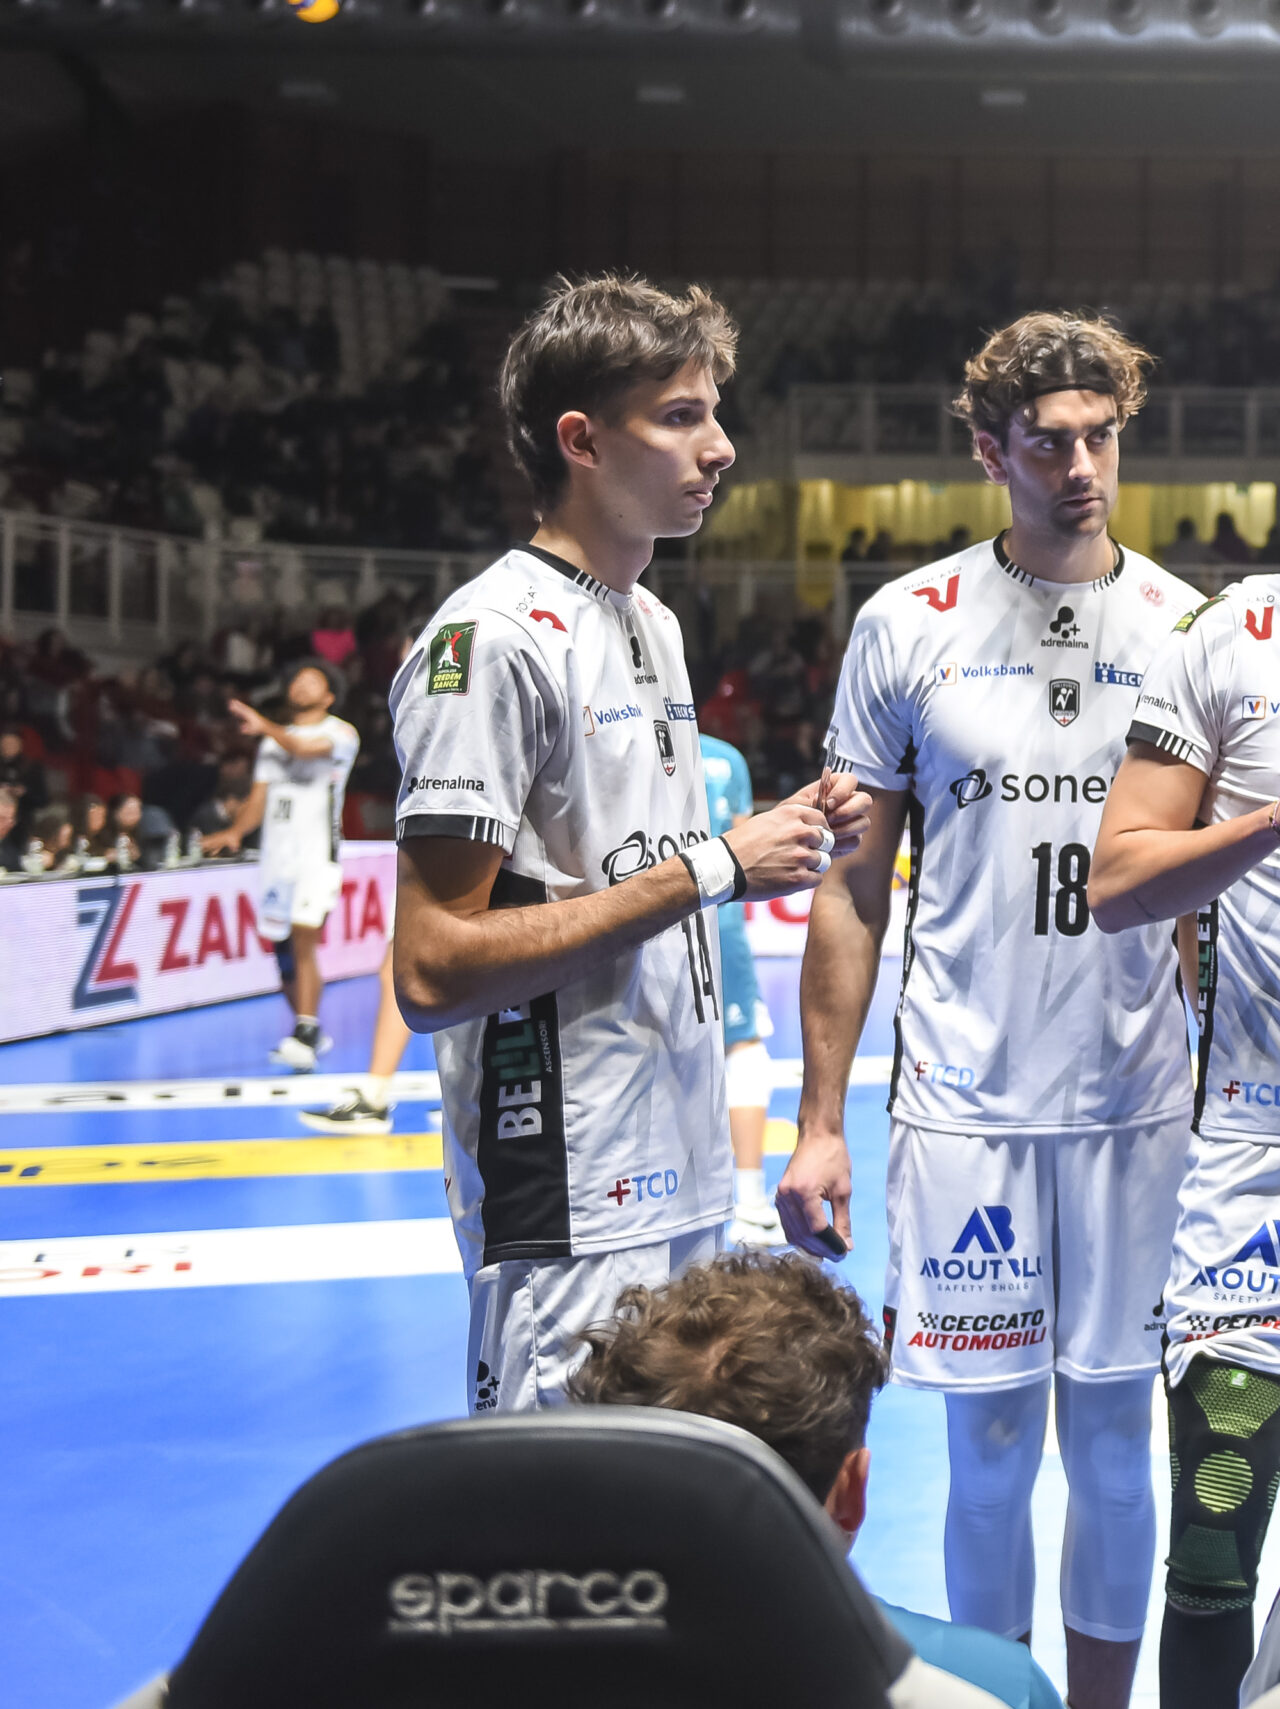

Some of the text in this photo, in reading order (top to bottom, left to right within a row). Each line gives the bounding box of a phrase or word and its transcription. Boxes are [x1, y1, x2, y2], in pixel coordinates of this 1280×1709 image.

[1041, 637, 1089, 649] adrenalina
[433, 672, 462, 682] CREDEM
[961, 663, 1034, 678] Volksbank
[433, 680, 459, 690] BANCA
[1001, 773, 1114, 804] sone
[1031, 841, 1091, 937] 18
[681, 910, 720, 1025] 14
[920, 1257, 1003, 1280] ABOUT
[937, 1283, 984, 1293] SAFETY
[1213, 1292, 1262, 1304] SAFETY
[940, 1308, 1045, 1332] CECCATO
[907, 1326, 1047, 1352] AUTOMOBILI
[388, 1568, 670, 1637] sparco
